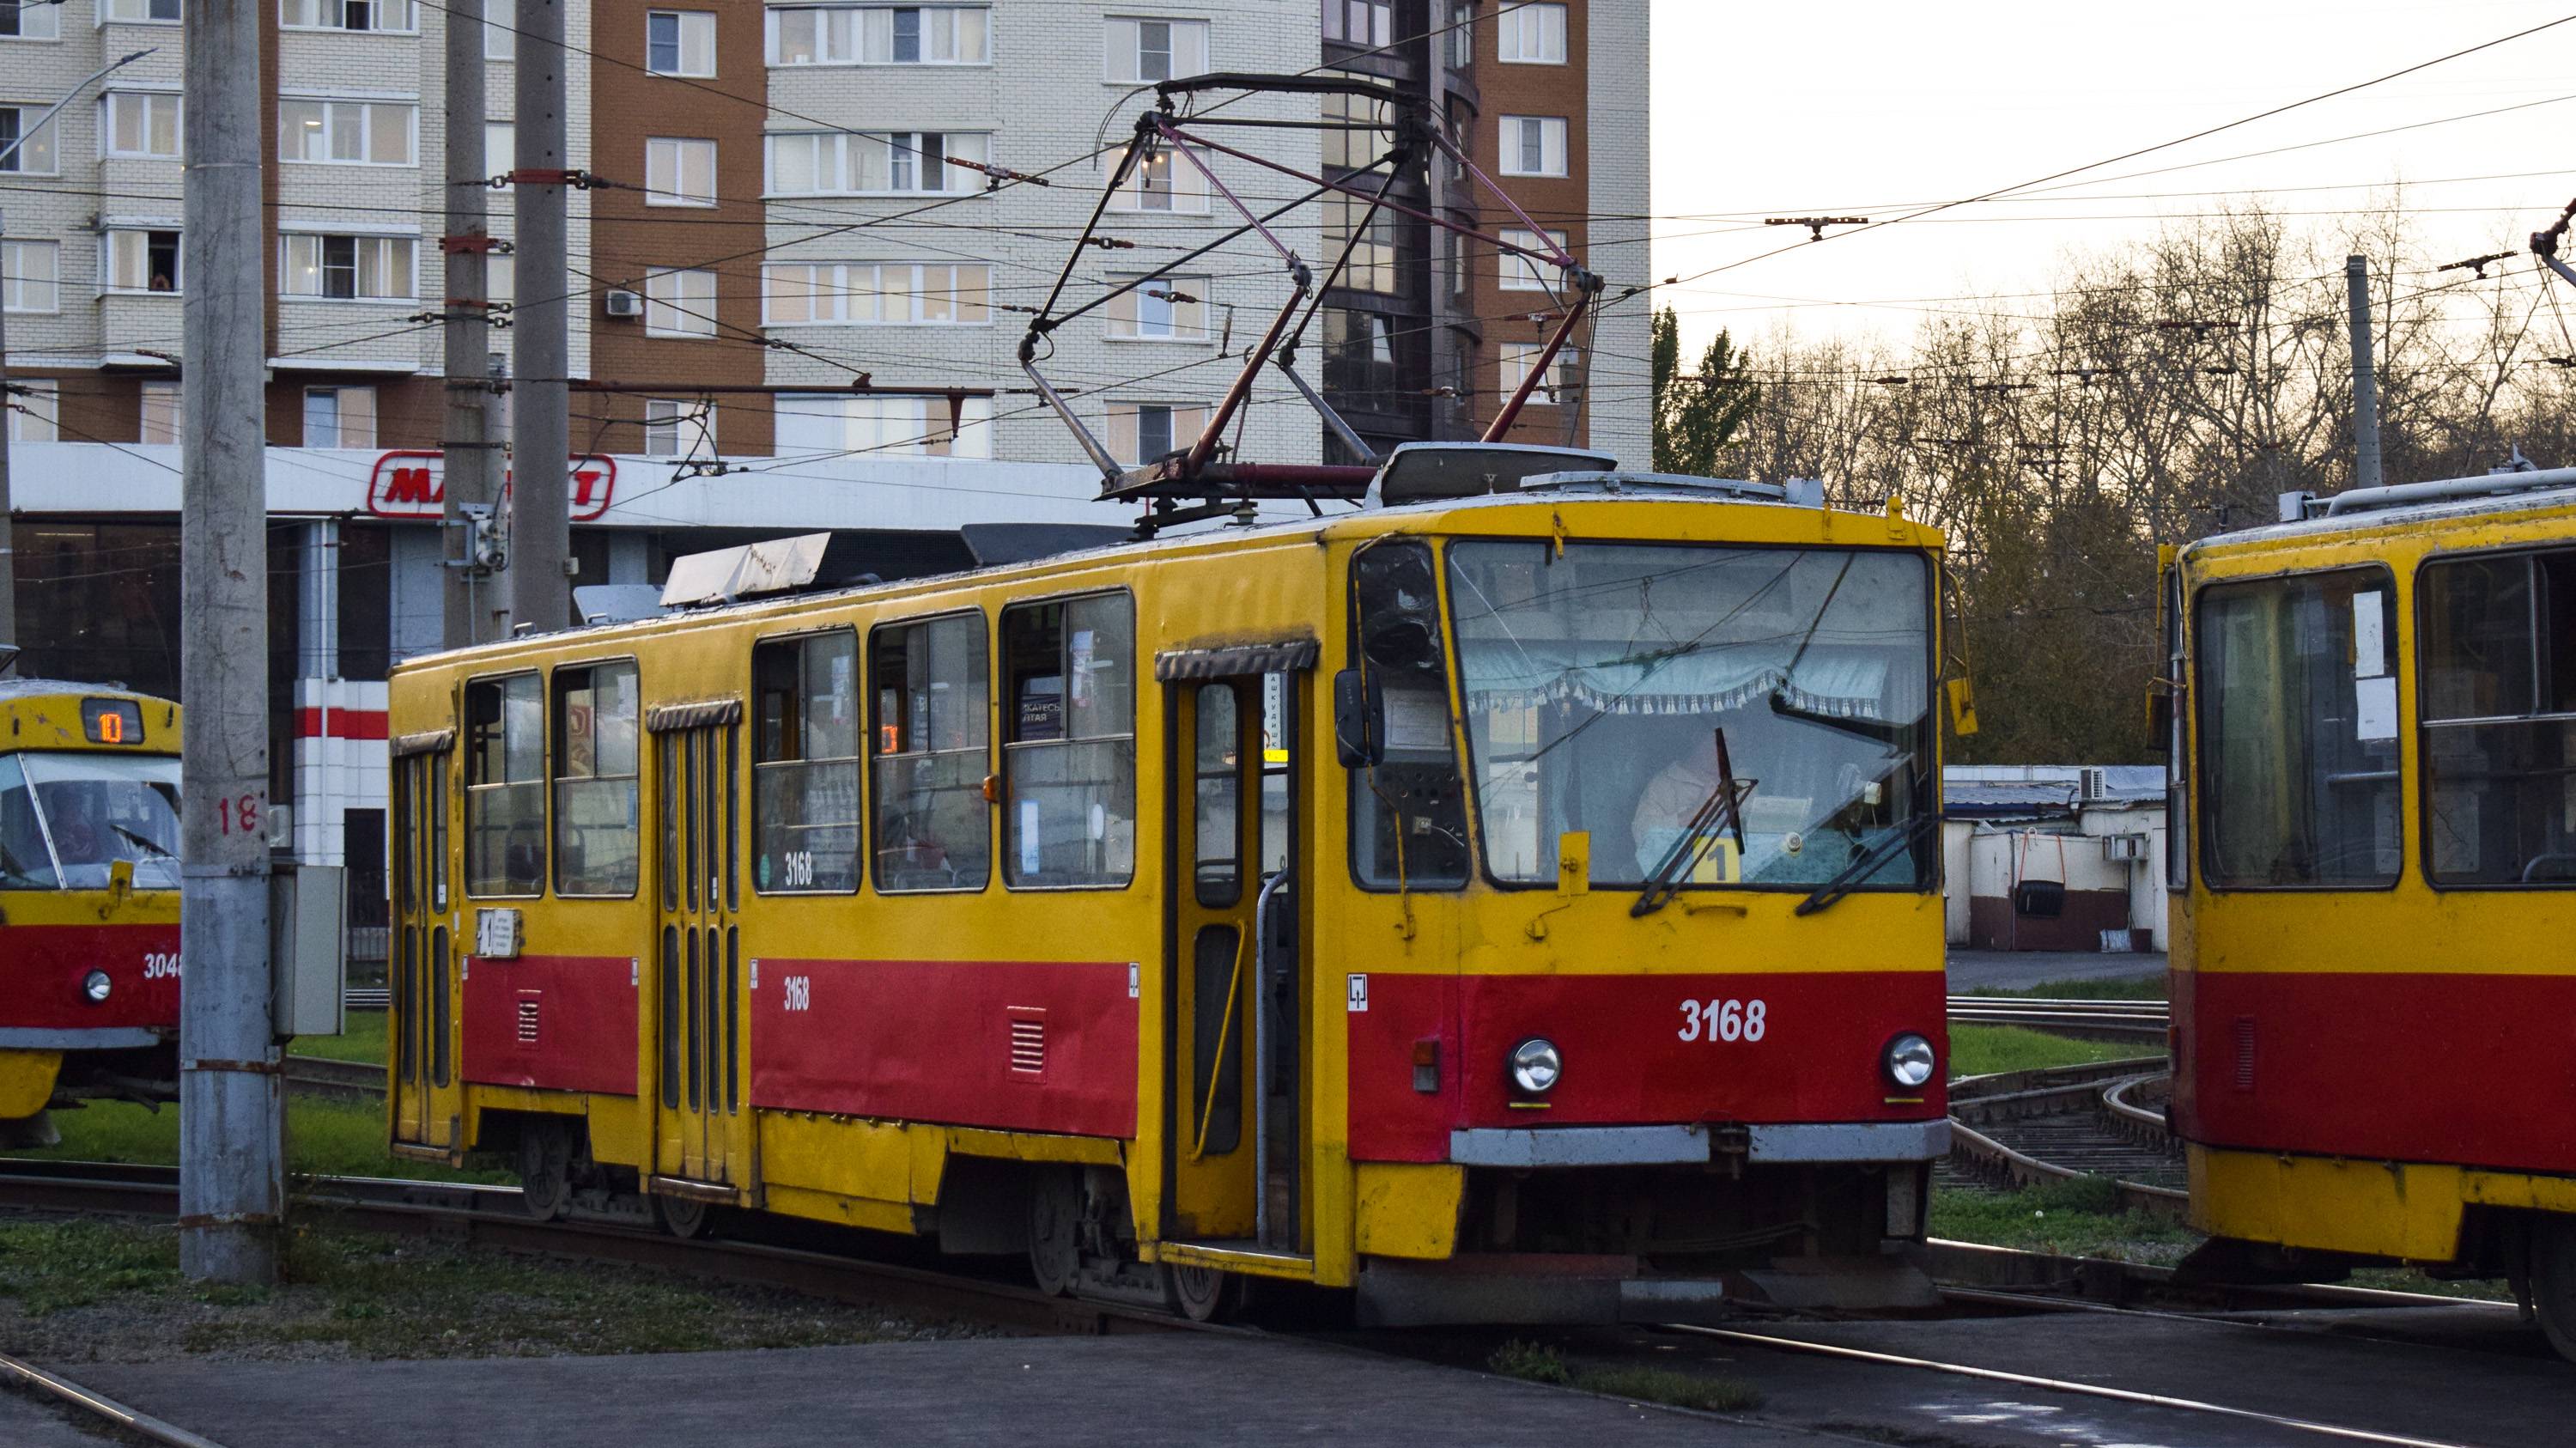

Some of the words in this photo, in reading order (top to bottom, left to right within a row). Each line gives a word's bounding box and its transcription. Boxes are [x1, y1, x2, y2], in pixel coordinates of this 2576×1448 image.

[100, 714, 122, 743] 10
[220, 794, 257, 836] 18
[786, 851, 812, 886] 3168
[1707, 844, 1726, 881] 1
[784, 976, 810, 1011] 3168
[1678, 999, 1766, 1043] 3168
